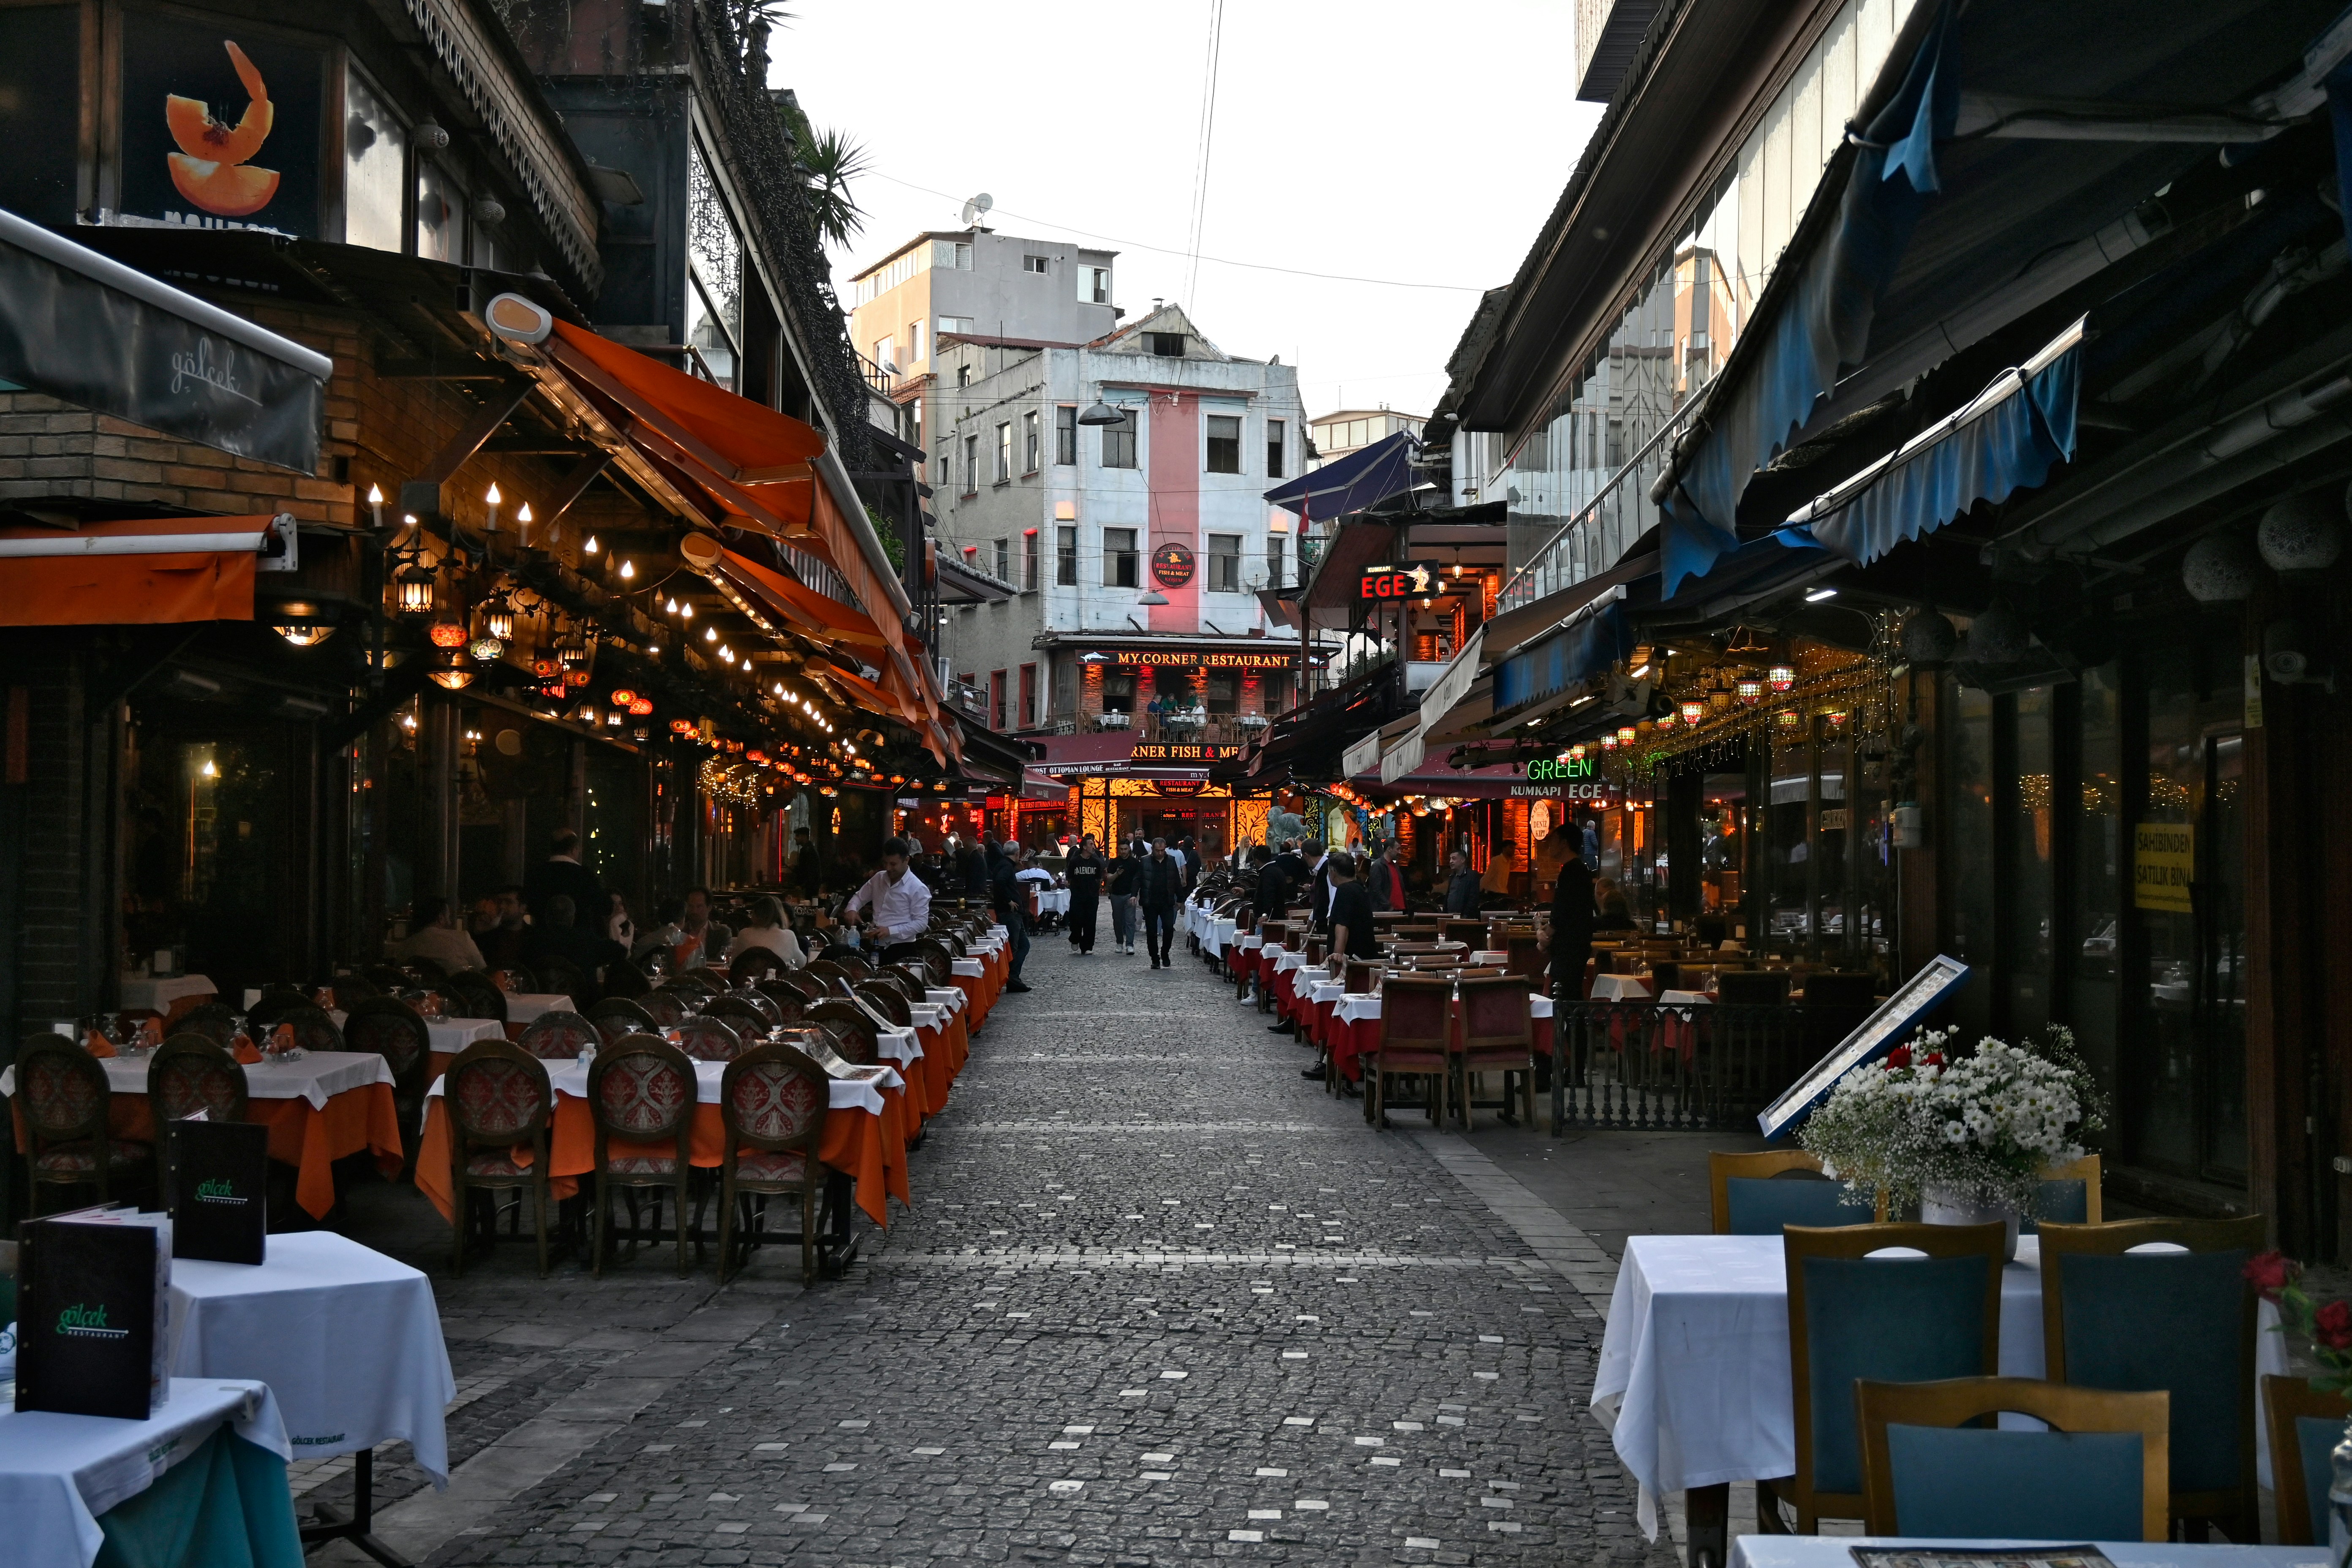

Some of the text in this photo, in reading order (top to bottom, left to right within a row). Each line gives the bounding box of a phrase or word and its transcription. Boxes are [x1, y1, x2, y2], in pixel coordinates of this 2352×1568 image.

[1361, 574, 1405, 598] EGE
[1118, 653, 1290, 666] MY.CORNER RESTAURANT
[1171, 746, 1201, 757] FISH
[1205, 746, 1215, 758] &
[1527, 758, 1591, 780] GREEN
[1511, 786, 1561, 796] KUMKAPI
[1568, 784, 1603, 799] EGE
[1533, 819, 1547, 828] DENİZ
[2138, 828, 2190, 853] SAHİBİNDEN
[2137, 864, 2168, 886] SATILIK
